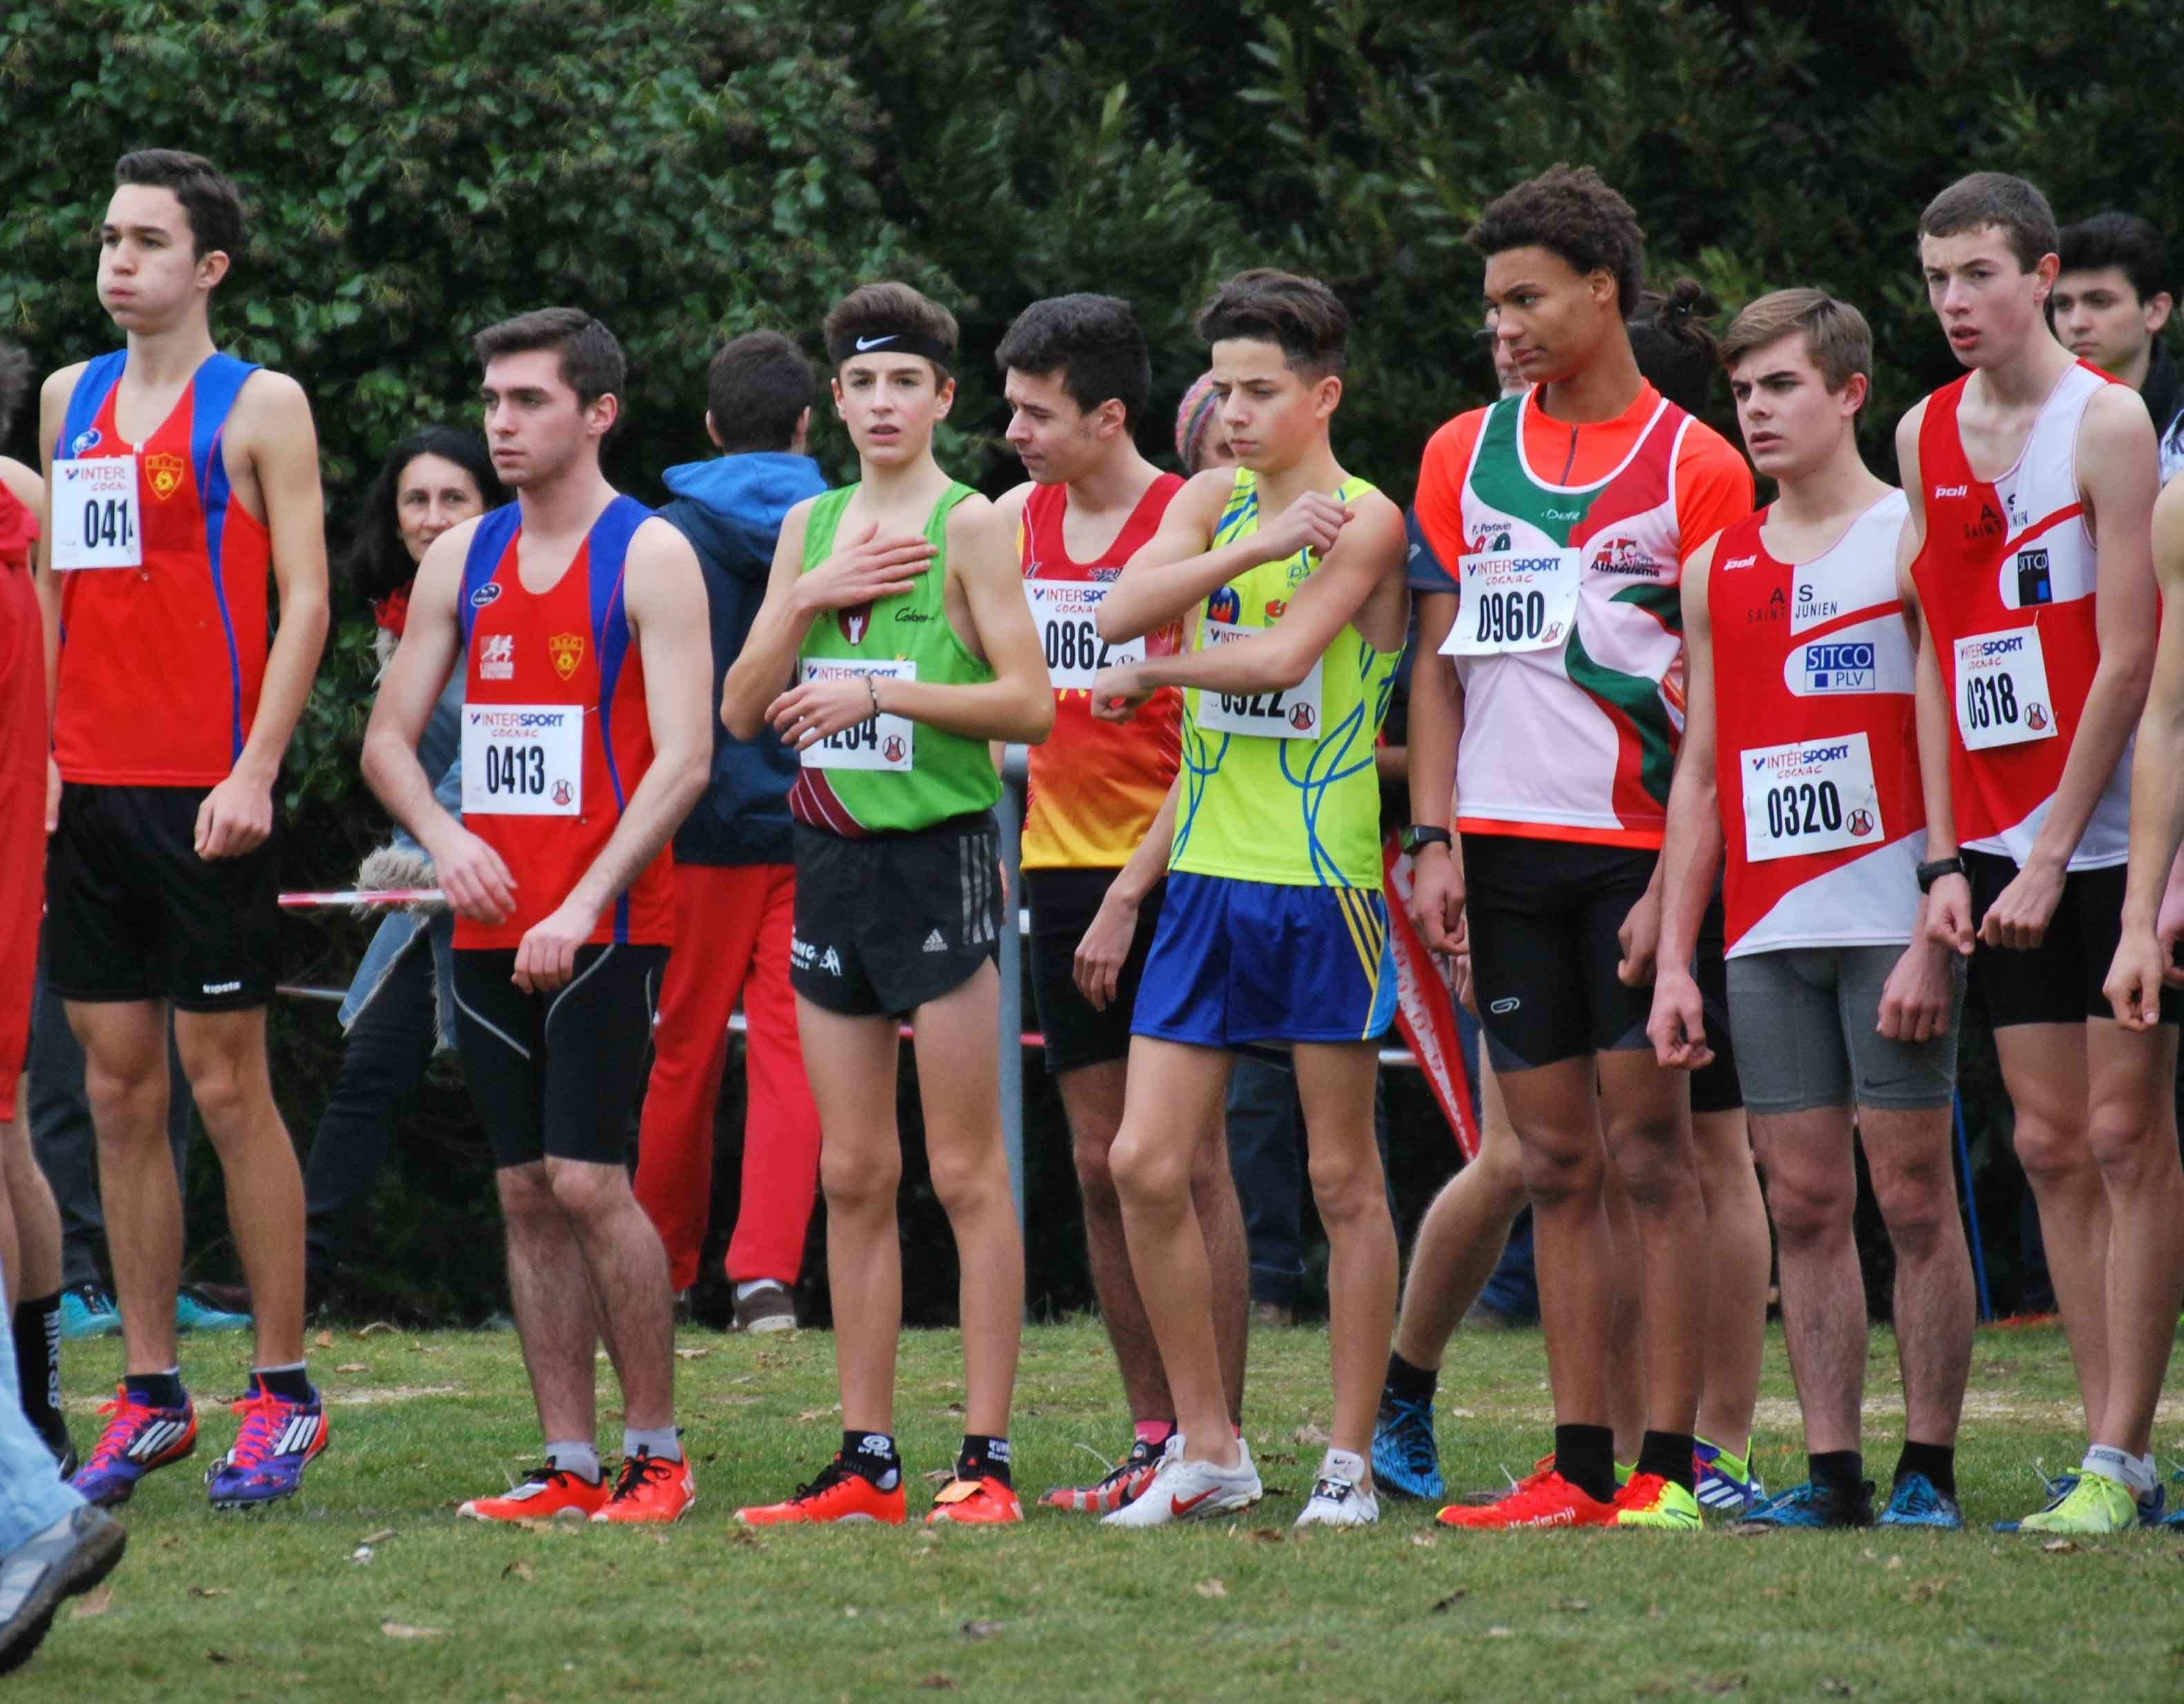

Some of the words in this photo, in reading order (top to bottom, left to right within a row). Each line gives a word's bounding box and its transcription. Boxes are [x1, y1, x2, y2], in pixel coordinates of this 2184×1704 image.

[1477, 557, 1561, 575] INTERSPORT
[1485, 574, 1534, 586] COGNAC
[1476, 590, 1545, 643] 0960
[1795, 602, 1837, 619] JUNIEN
[1808, 645, 1872, 670] SITCO
[1836, 671, 1864, 686] PLV
[1968, 672, 2018, 730] 0318
[483, 713, 564, 727] INTERSPORT
[492, 728, 539, 738] COGNAC
[1767, 745, 1848, 769] INTERSPORT
[487, 745, 545, 795] 0413
[1777, 765, 1823, 780] COGNAC
[1768, 780, 1842, 839] 0320
